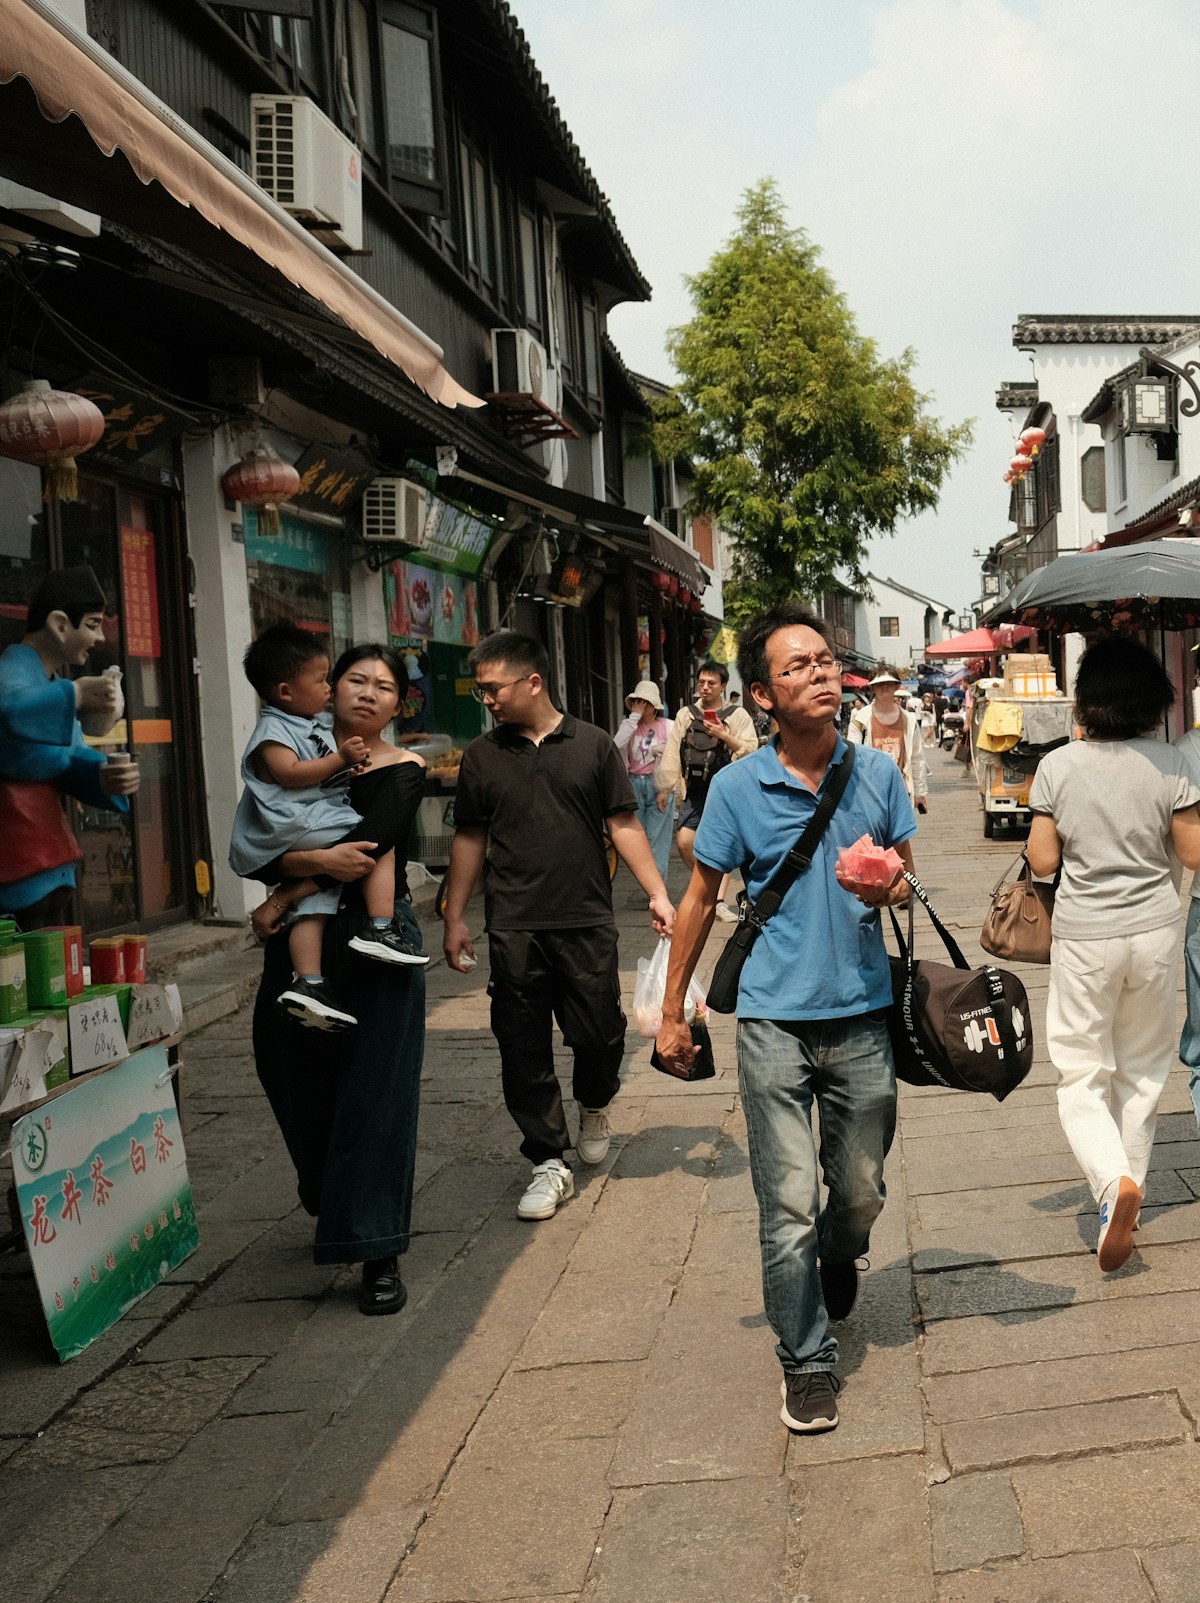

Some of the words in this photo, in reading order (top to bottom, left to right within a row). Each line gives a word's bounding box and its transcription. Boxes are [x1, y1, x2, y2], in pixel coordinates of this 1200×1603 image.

[130, 1115, 174, 1176] 白茶
[30, 1154, 114, 1247] 龙井茶
